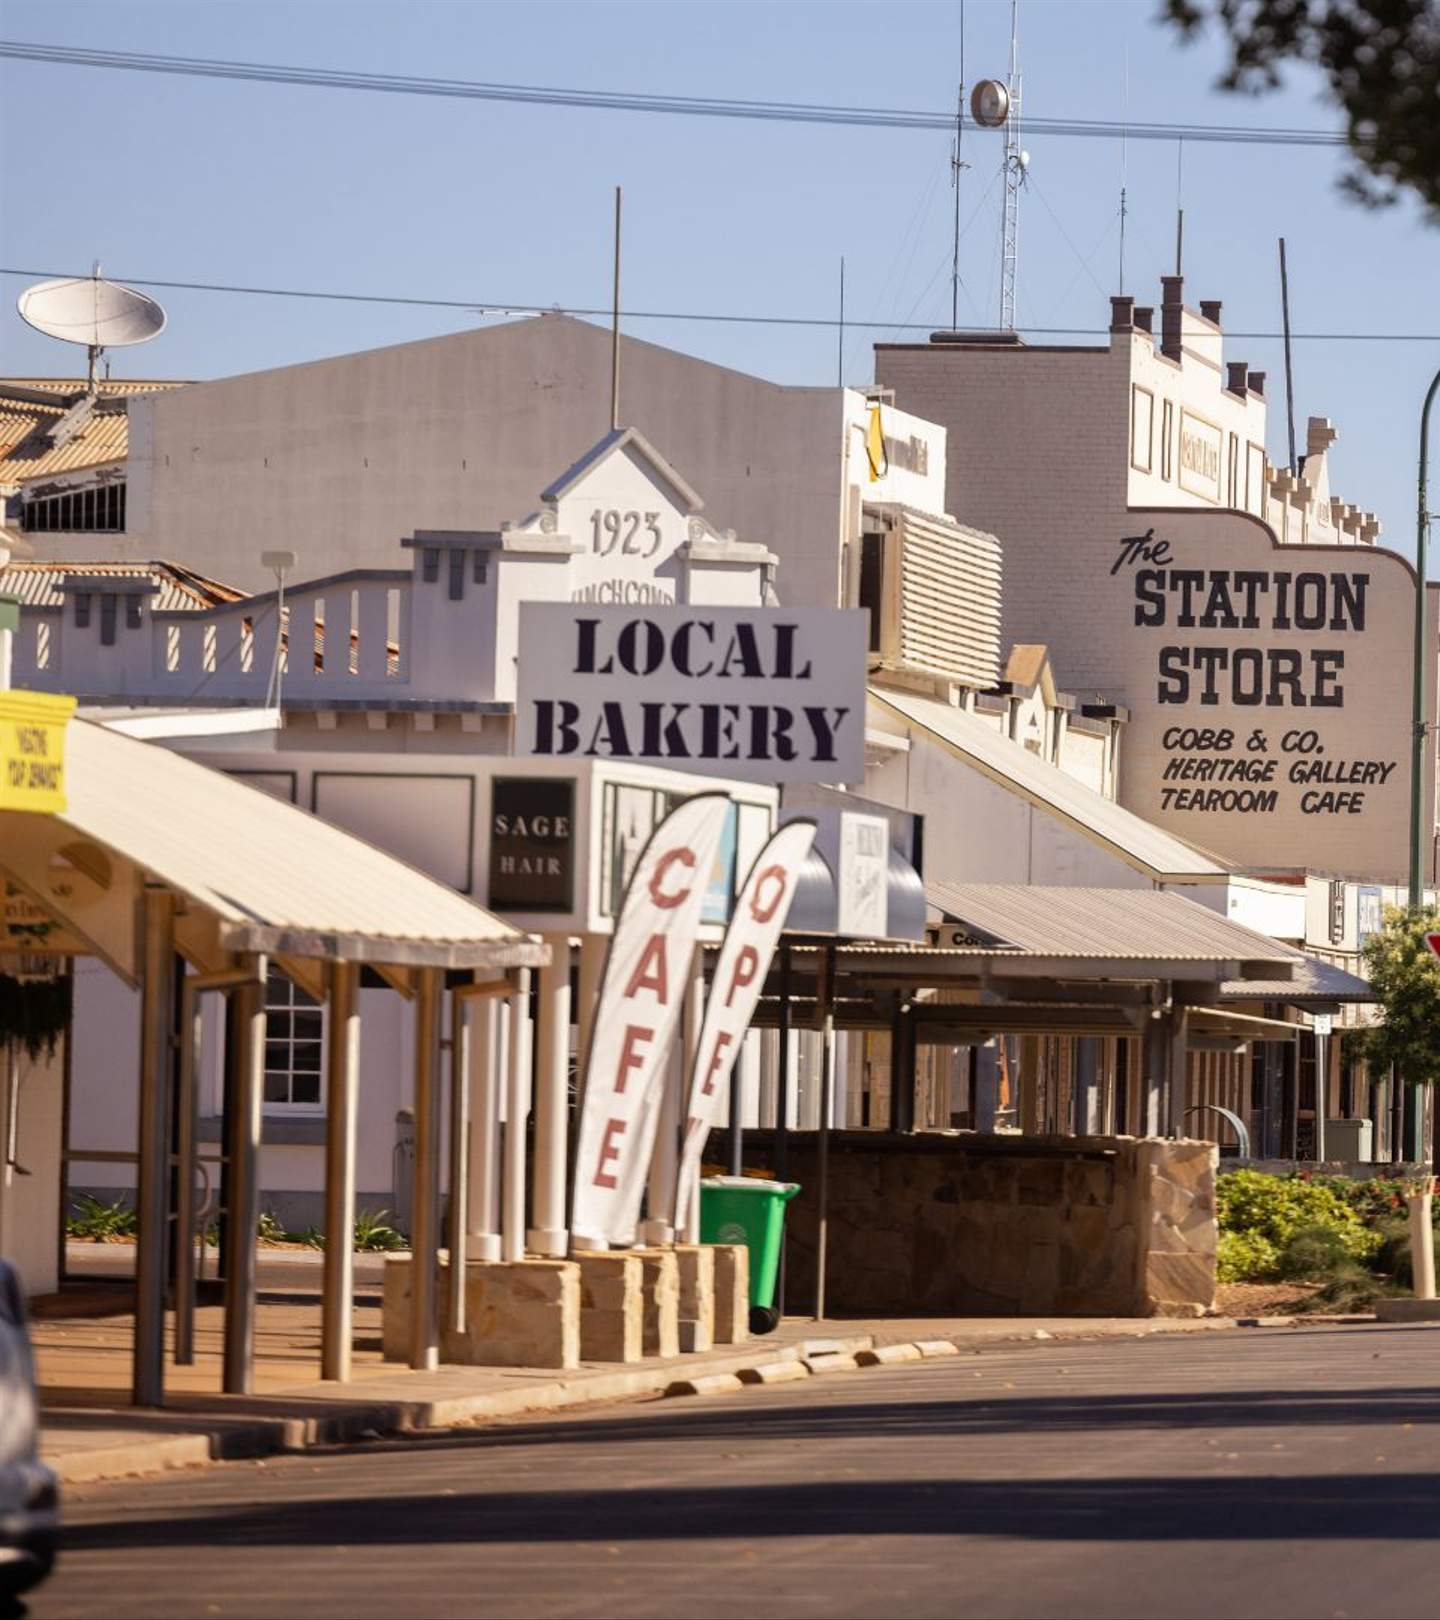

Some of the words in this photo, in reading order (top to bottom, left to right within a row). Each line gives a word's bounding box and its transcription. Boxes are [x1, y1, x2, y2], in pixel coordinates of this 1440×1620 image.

[590, 508, 662, 558] 1923
[1110, 528, 1174, 575] The
[1134, 569, 1370, 632] STATION
[573, 618, 812, 680] LOCAL
[1157, 645, 1345, 708] STORE
[531, 699, 851, 762] BAKERY
[1162, 727, 1235, 751] COBB
[1246, 729, 1268, 753] &
[1280, 729, 1325, 755] CO.
[1161, 757, 1279, 784] HERITAGE
[1288, 759, 1397, 785] GALLERY
[1160, 787, 1279, 813] TEAROOM
[1300, 790, 1366, 814] CAFE
[495, 814, 569, 838] SAGE
[501, 855, 562, 876] HAIR
[592, 846, 697, 1190] CAFE
